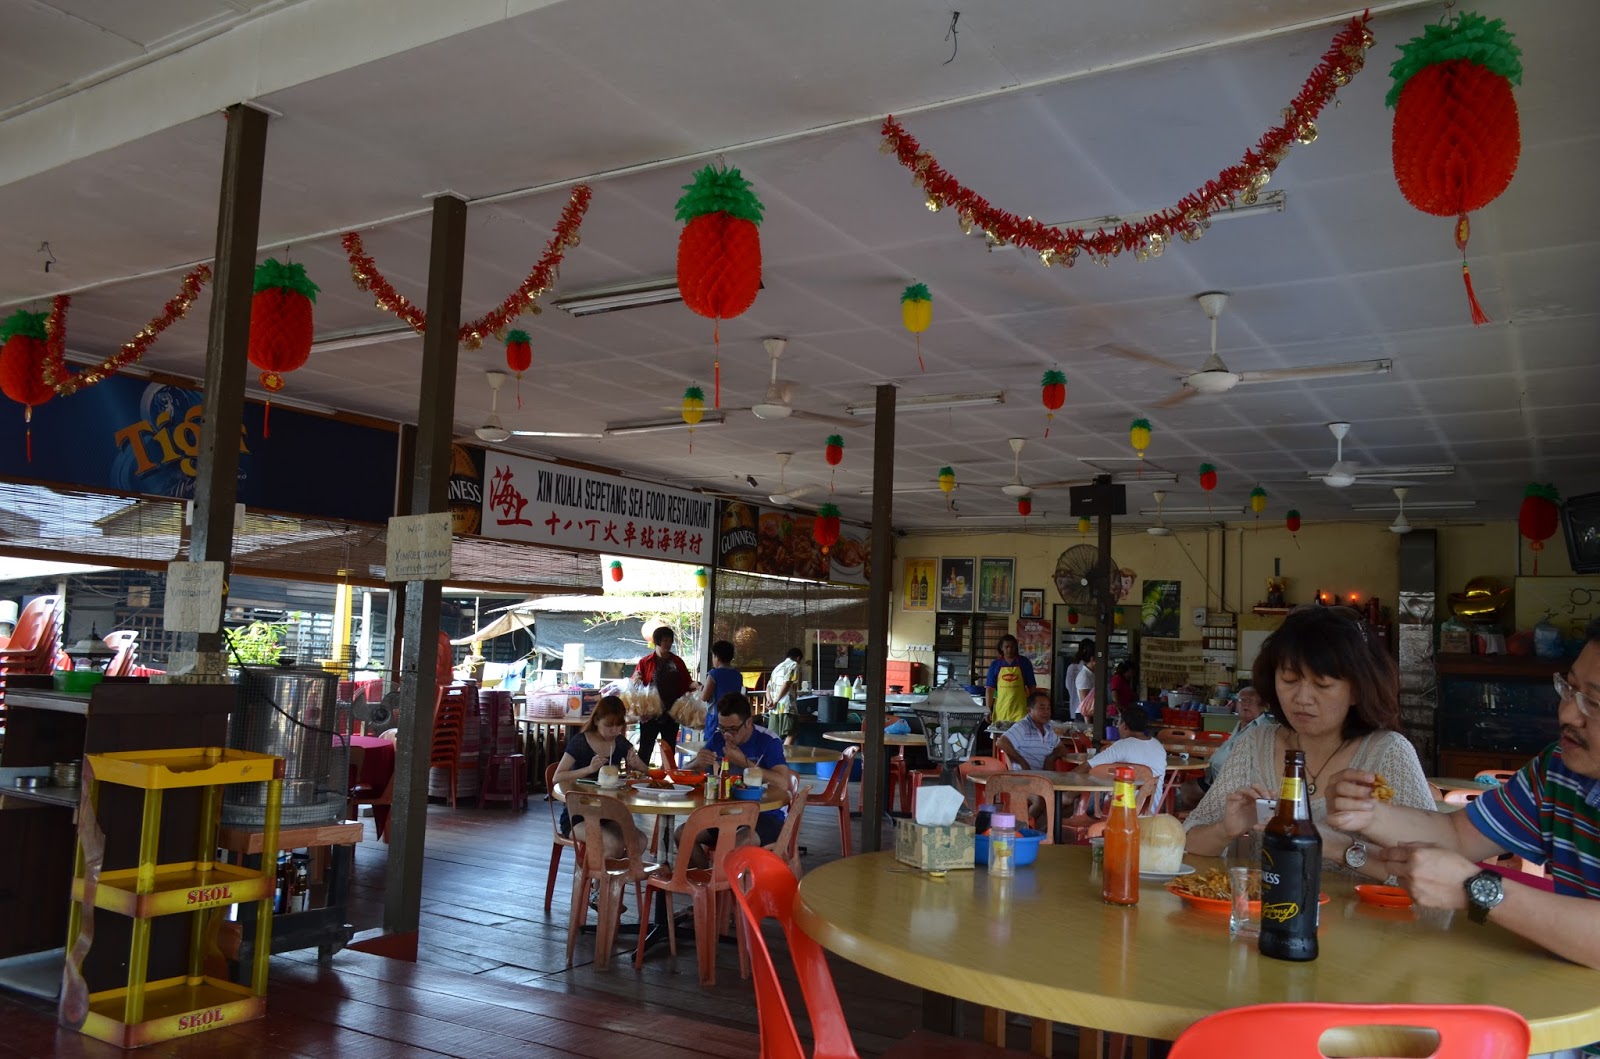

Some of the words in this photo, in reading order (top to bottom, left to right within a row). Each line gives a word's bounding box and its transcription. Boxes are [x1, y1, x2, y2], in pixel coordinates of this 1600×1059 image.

[114, 404, 250, 477] Tig
[536, 469, 553, 503] XIN
[554, 473, 582, 508] KUALA
[584, 478, 628, 517] SEPETANG
[628, 487, 644, 519] SEA
[645, 490, 666, 523] FOOD
[667, 492, 713, 531] RESTAURANT
[721, 530, 758, 554] GUINNESS
[187, 885, 233, 905] SKOL
[178, 1007, 224, 1031] SKOL
